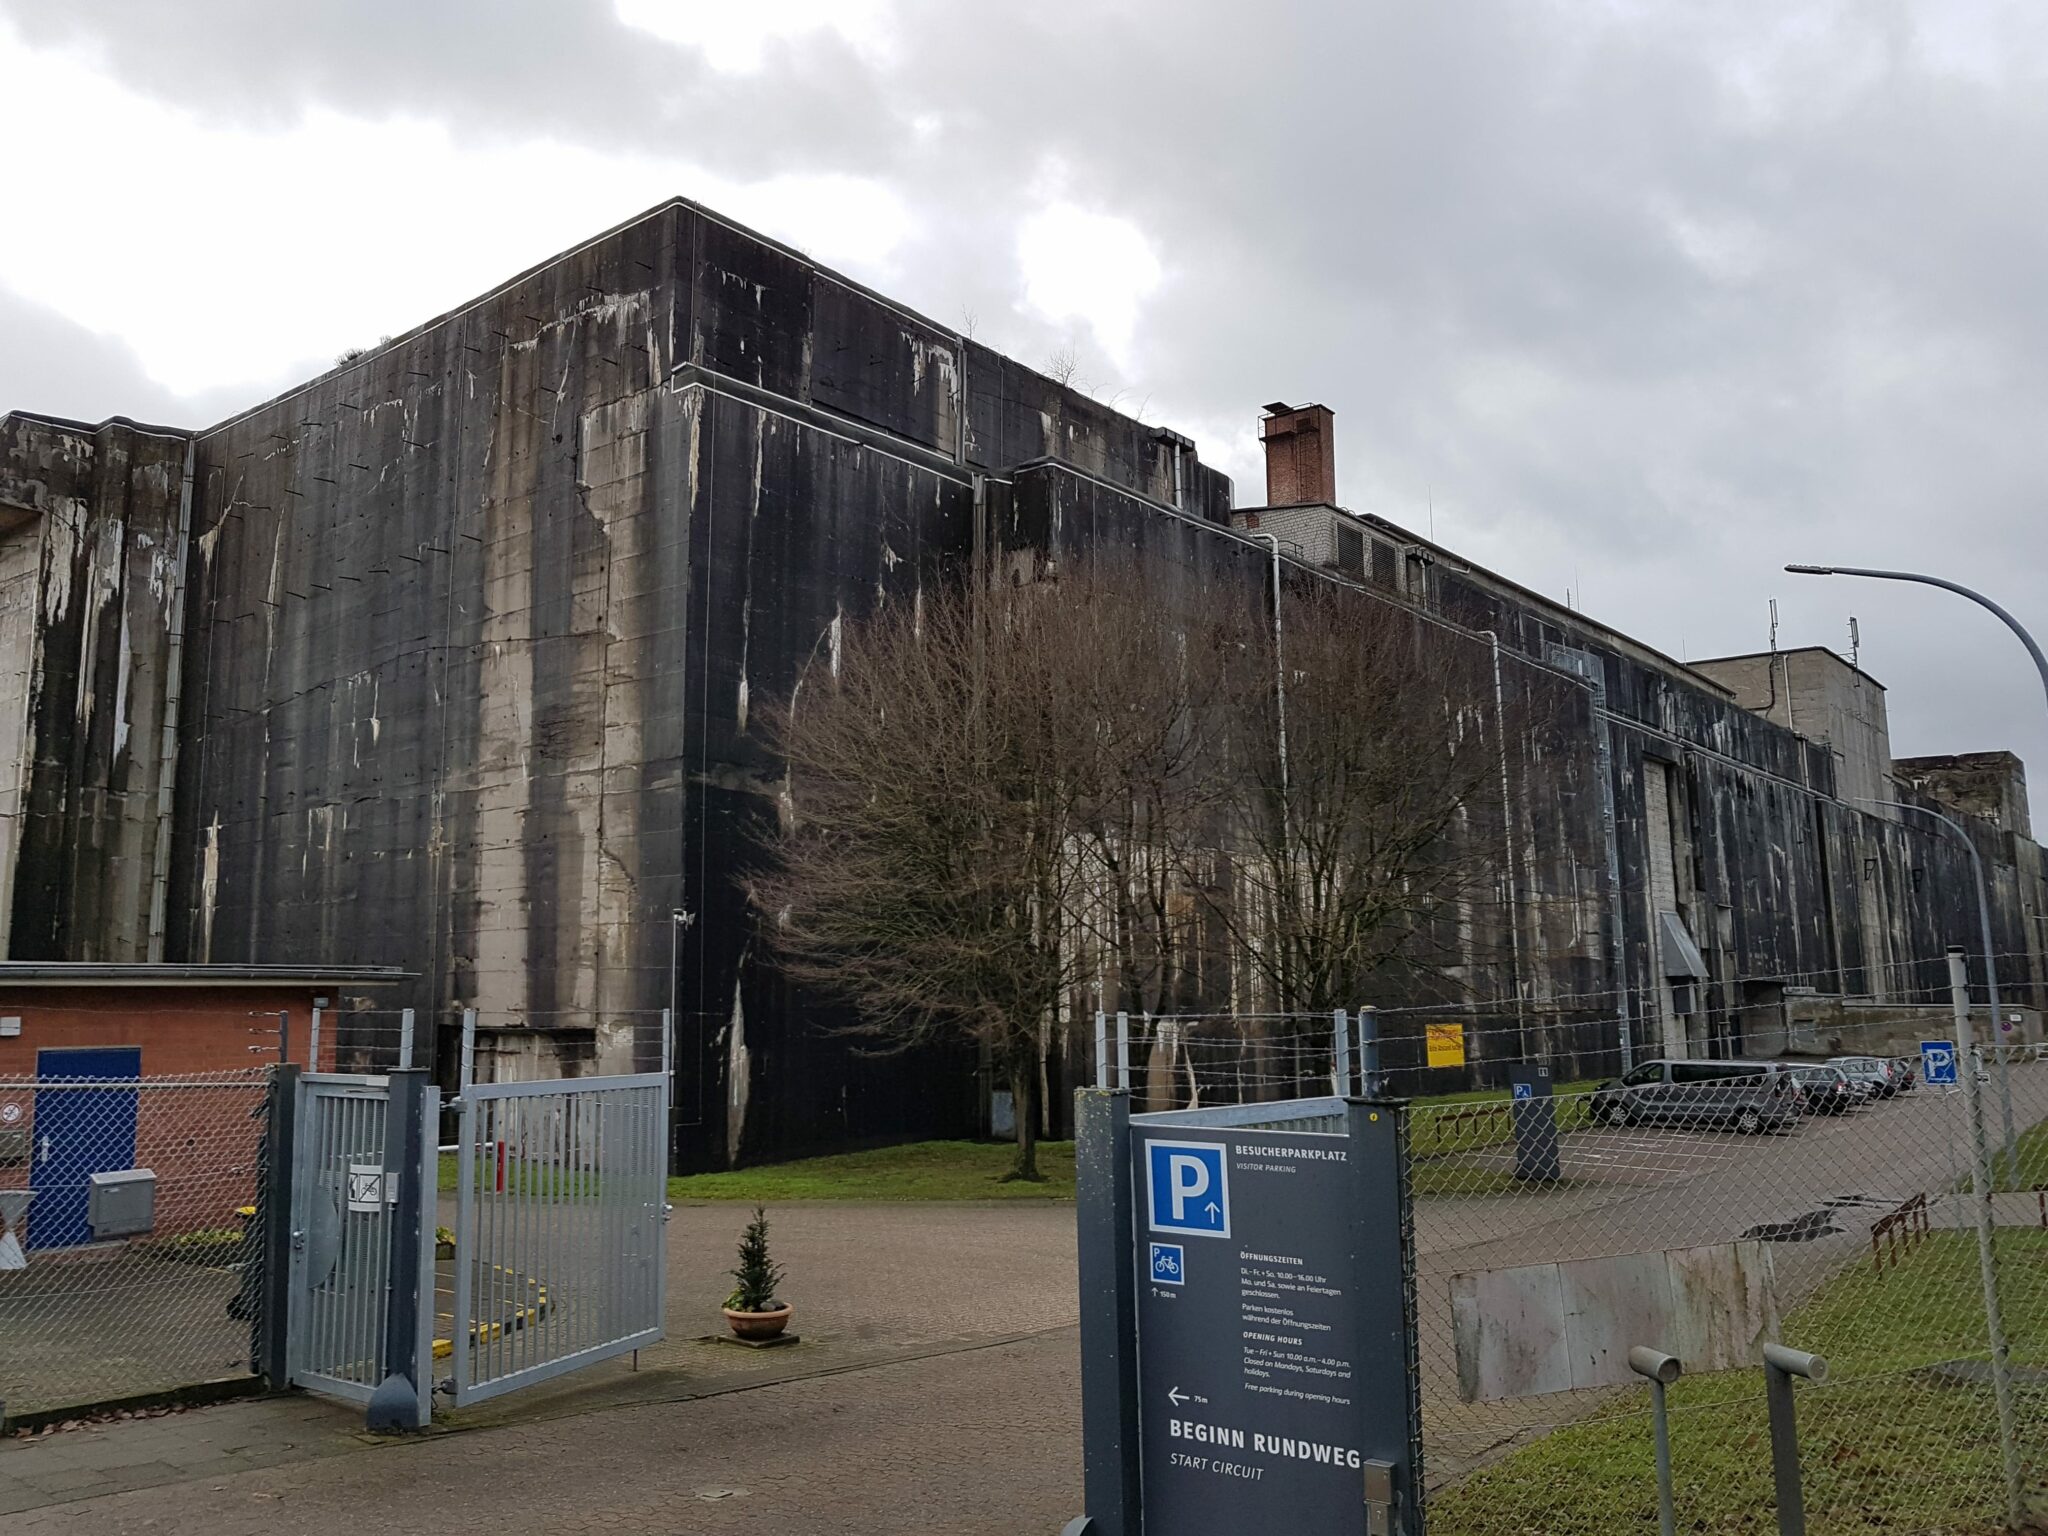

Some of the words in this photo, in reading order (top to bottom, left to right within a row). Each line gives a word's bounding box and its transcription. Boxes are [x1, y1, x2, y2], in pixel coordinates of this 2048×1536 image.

[1926, 1048, 1951, 1077] P
[1516, 1086, 1524, 1096] P
[1235, 1145, 1347, 1161] BESUCHERPARKPLATZ
[1236, 1163, 1263, 1171] VISITOR
[1265, 1164, 1297, 1173] PARKING
[1170, 1154, 1210, 1220] P
[1153, 1247, 1161, 1257] P
[1240, 1251, 1303, 1265] ÖFFNUNGSZEITEN
[1241, 1289, 1280, 1299] geschlossen.
[1253, 1279, 1266, 1287] und
[1278, 1283, 1296, 1291] sowie
[1306, 1285, 1341, 1297] Feiertagen
[1242, 1303, 1263, 1312] Parken
[1264, 1305, 1294, 1316] kostenlos
[1242, 1314, 1269, 1324] während
[1270, 1316, 1281, 1325] der
[1282, 1317, 1331, 1331] Öffnungszeiten
[1243, 1331, 1275, 1342] OPENING
[1277, 1335, 1303, 1346] HOURS
[1243, 1346, 1255, 1354] Tue
[1259, 1348, 1268, 1356] Fri
[1273, 1350, 1285, 1359] Sun
[1286, 1353, 1302, 1361] 10.00
[1336, 1360, 1351, 1369] p.m.
[1243, 1357, 1264, 1366] Closed
[1274, 1361, 1304, 1373] Mondays,
[1305, 1365, 1337, 1377] Saturdays
[1337, 1371, 1351, 1379] and
[1243, 1367, 1271, 1378] holidays.
[1245, 1382, 1258, 1391] Free
[1259, 1385, 1283, 1396] parking
[1283, 1388, 1304, 1399] during
[1305, 1392, 1331, 1403] opening
[1331, 1395, 1350, 1405] hours
[1170, 1419, 1245, 1449] BEGINN
[1254, 1433, 1361, 1469] RUNDWEG
[1170, 1452, 1208, 1471] START
[1212, 1460, 1265, 1481] CIRCUIT
